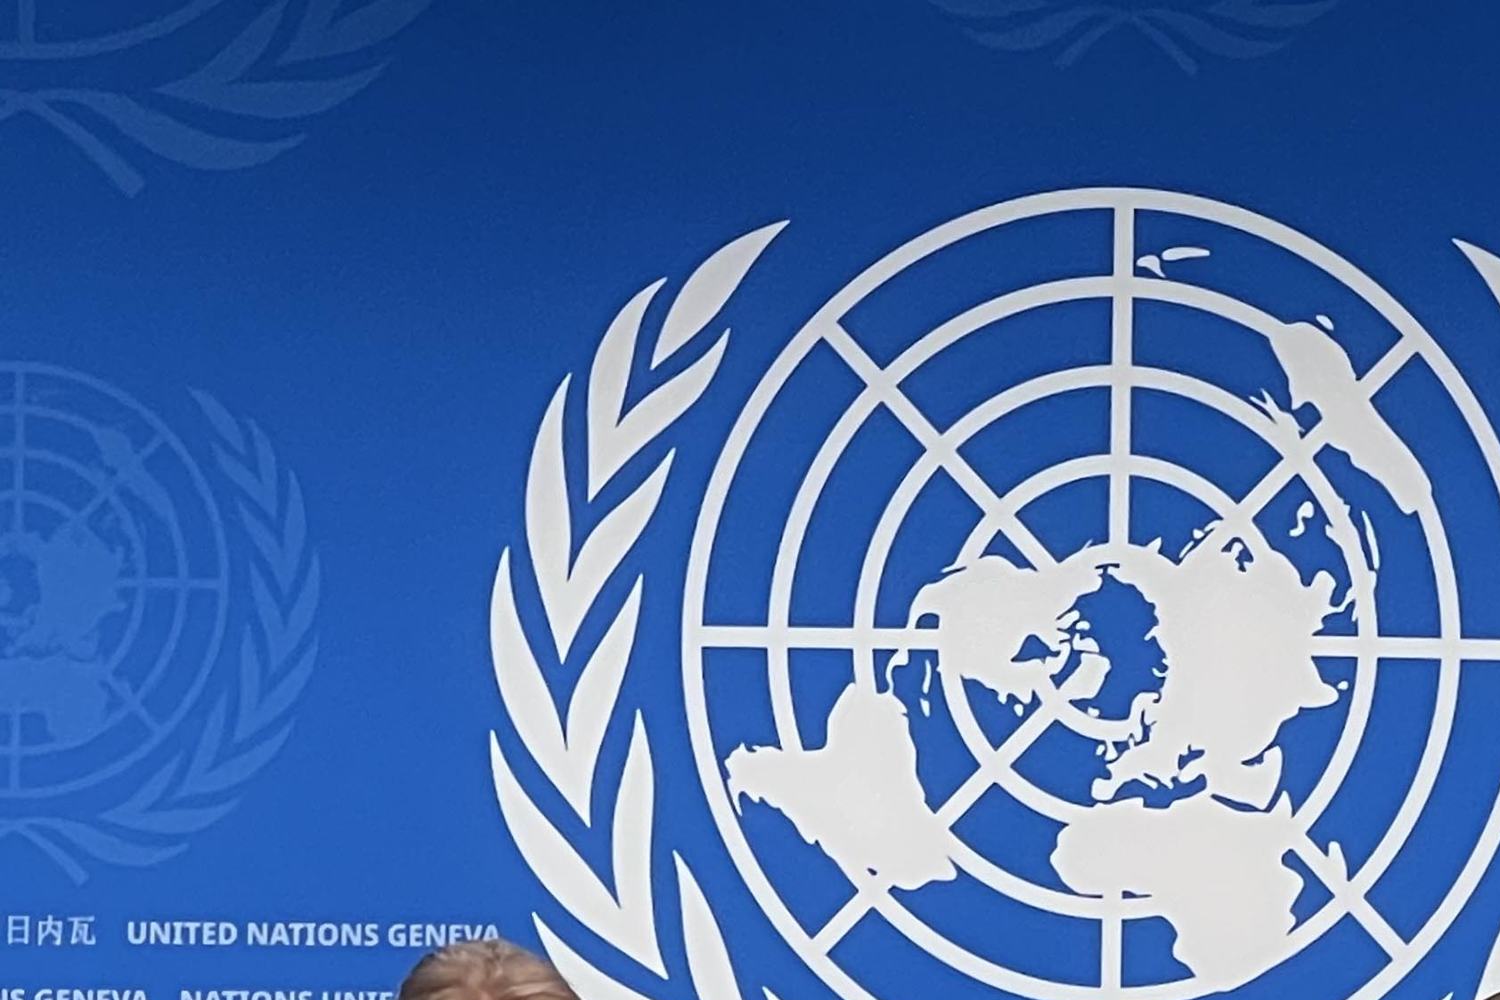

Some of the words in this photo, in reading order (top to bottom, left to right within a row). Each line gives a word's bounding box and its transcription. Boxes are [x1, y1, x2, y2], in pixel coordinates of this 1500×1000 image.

[7, 914, 96, 946] 日内瓦
[127, 921, 238, 946] UNITED
[247, 922, 379, 947] NATIONS
